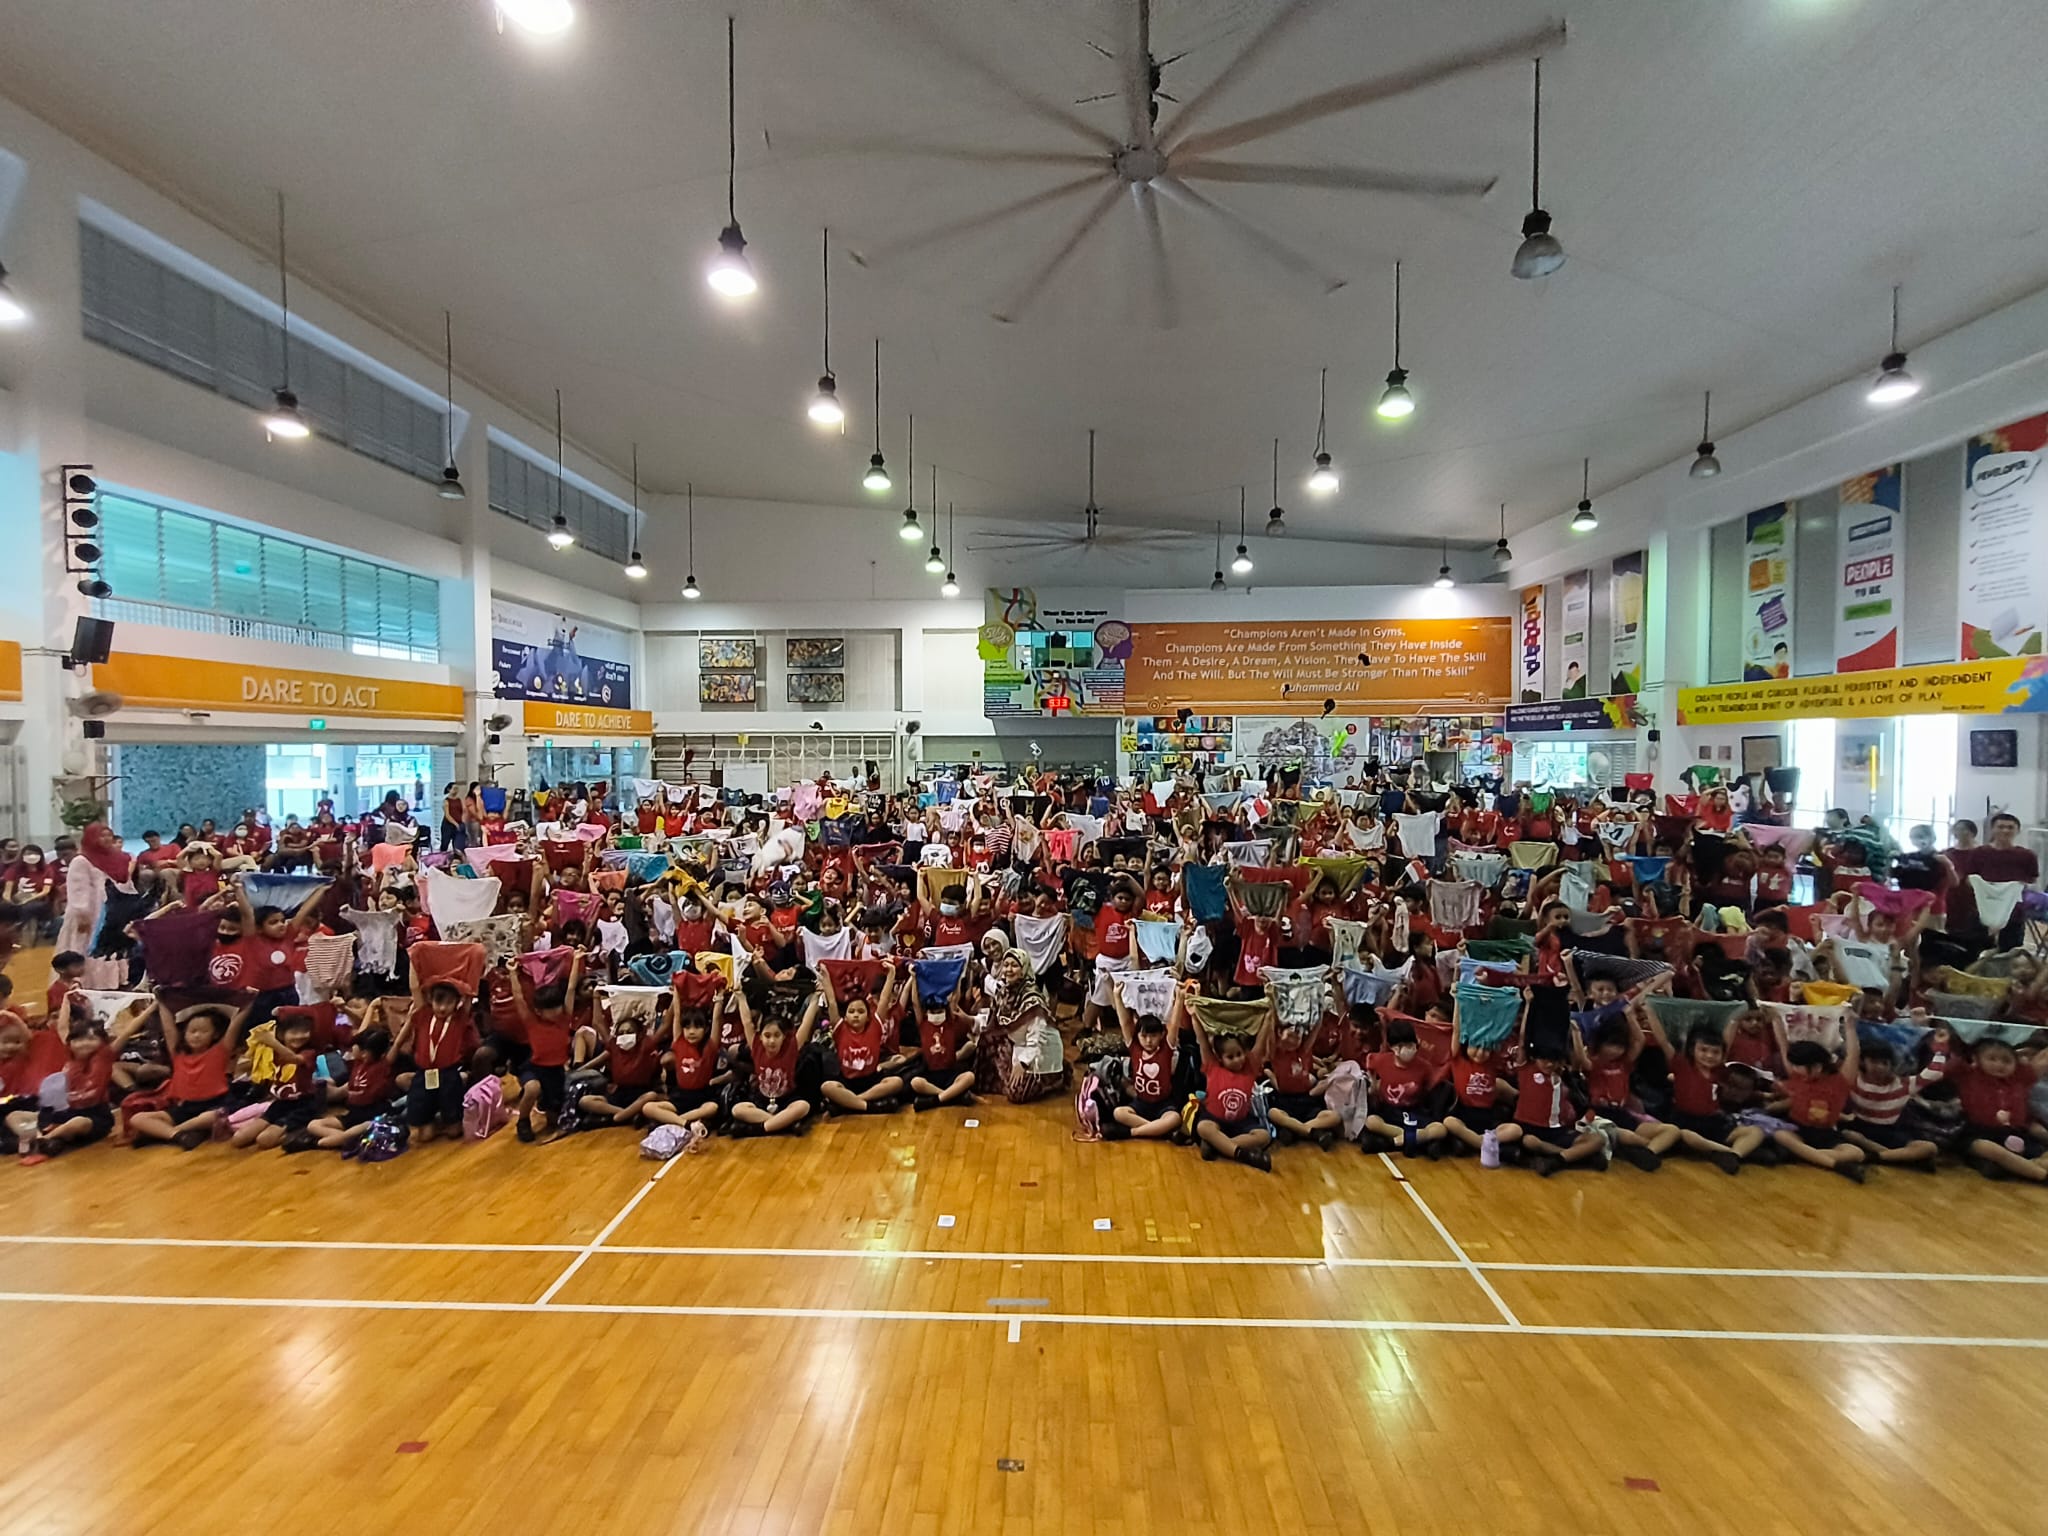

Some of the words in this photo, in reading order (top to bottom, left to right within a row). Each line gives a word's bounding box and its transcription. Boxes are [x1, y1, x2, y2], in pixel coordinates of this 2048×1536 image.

[1847, 557, 1891, 584] PEOPLE
[1328, 627, 1356, 637] Made
[1360, 627, 1370, 636] In
[1373, 626, 1406, 639] Gyms.
[1165, 643, 1222, 654] Champions
[1226, 643, 1244, 653] Are
[1247, 642, 1276, 652] Made
[1279, 641, 1307, 651] From
[1310, 640, 1367, 652] Something
[1370, 641, 1397, 652] They
[1400, 640, 1427, 650] Have
[1430, 639, 1463, 650] Inside
[1142, 656, 1172, 667] Them
[1182, 656, 1190, 666] A
[1192, 656, 1230, 668] Desire,
[1232, 656, 1240, 666] A
[1242, 655, 1281, 668] Dream,
[1283, 655, 1292, 665] A
[1294, 654, 1330, 665] Vision.
[1334, 654, 1359, 666] They
[1393, 654, 1406, 664] To
[1409, 653, 1437, 663] Have
[1440, 652, 1460, 663] The
[1463, 652, 1487, 662] Skill
[1152, 670, 1174, 680] And
[1176, 670, 1197, 680] The
[1200, 670, 1225, 680] Will.
[1228, 670, 1246, 680] But
[1249, 669, 1270, 679] The
[1273, 669, 1293, 679] Will
[1296, 669, 1322, 679] Must
[1325, 668, 1339, 678] Be
[1342, 668, 1387, 679] Stronger
[1392, 667, 1418, 677] Than
[1421, 667, 1442, 677] The
[1845, 679, 1893, 691] PERSISTENT
[1899, 677, 1918, 688] AND
[1925, 671, 1992, 686] INDEPENDENT
[241, 675, 303, 704] DARE
[308, 681, 338, 706] TO
[342, 685, 380, 709] ACT
[1344, 681, 1360, 691] Ali
[1785, 700, 1795, 709] OF
[1870, 694, 1894, 704] LOVE
[1899, 692, 1912, 703] OF
[1918, 691, 1942, 702] PLAY
[556, 710, 581, 728] DARE
[584, 712, 596, 728] TO
[597, 714, 632, 730] ACHIEVE
[1136, 1058, 1143, 1076] I
[1135, 1076, 1161, 1095] SG
